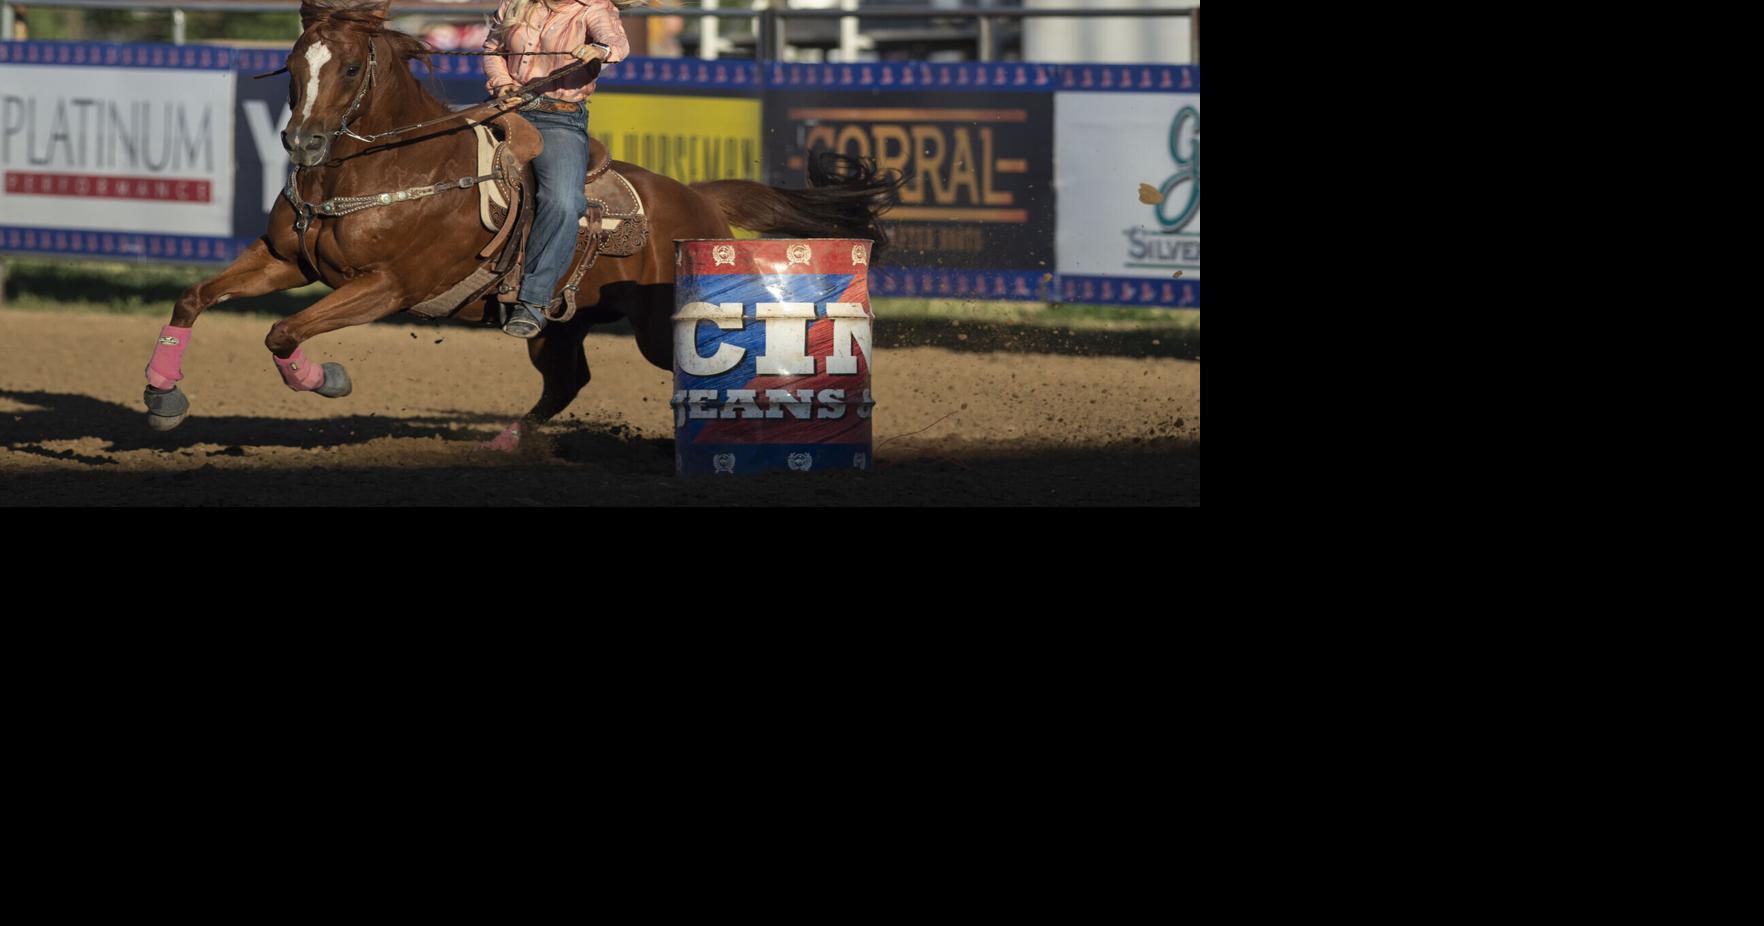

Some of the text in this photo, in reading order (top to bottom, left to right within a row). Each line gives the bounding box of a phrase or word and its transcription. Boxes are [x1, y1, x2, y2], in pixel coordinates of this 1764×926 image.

[2, 95, 213, 172] PLATINUM
[8, 174, 209, 201] PERFORMANCE
[672, 389, 847, 427] JEANS
